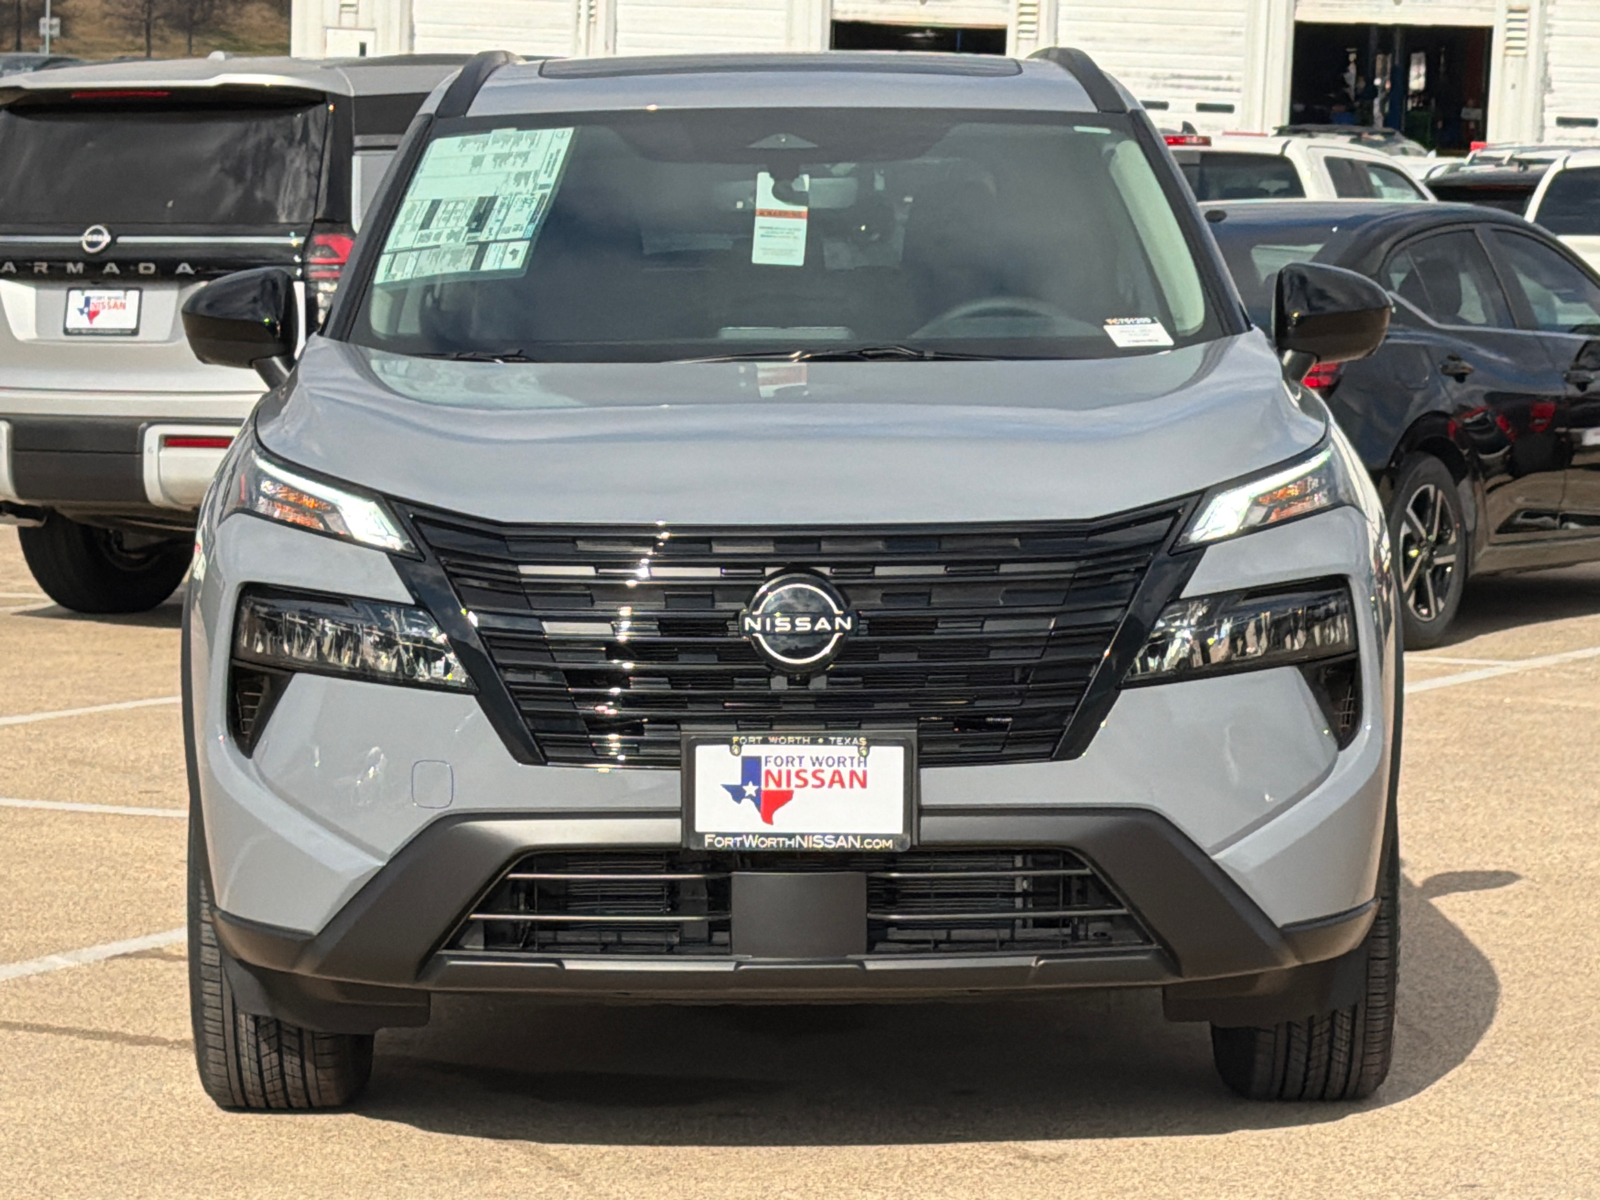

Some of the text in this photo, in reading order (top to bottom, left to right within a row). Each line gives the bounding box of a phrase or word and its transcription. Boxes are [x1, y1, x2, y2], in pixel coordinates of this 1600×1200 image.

[1, 261, 195, 275] ARMADA
[91, 301, 126, 310] NISSAN
[744, 616, 852, 632] NISSAN
[732, 736, 867, 746] FORT WORTH TEXAS
[764, 755, 867, 768] FORT WORTH
[764, 769, 868, 789] NISSAN
